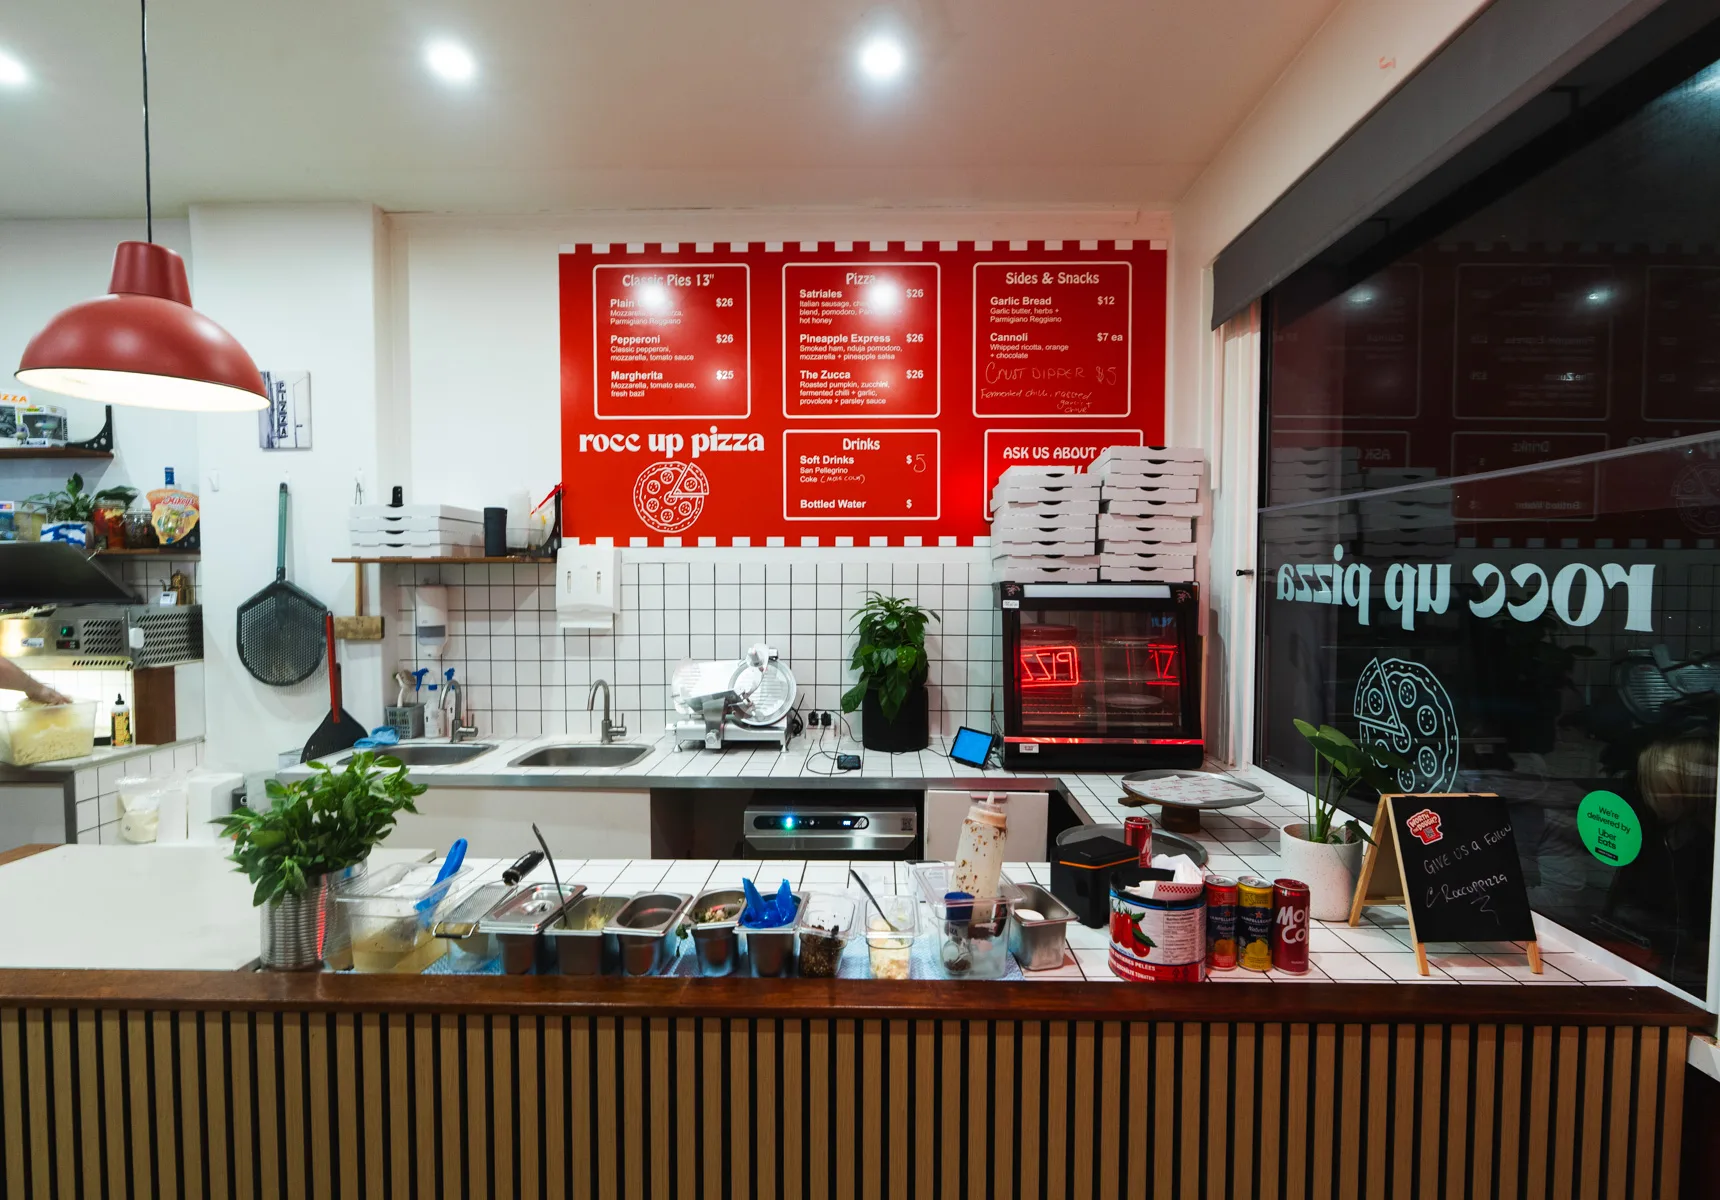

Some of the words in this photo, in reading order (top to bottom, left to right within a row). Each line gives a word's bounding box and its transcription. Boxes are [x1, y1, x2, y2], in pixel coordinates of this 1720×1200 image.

[622, 274, 664, 287] Classic
[667, 274, 692, 287] Pies
[846, 272, 876, 285] Pizza
[1006, 272, 1038, 284] Sides
[1042, 272, 1054, 284] &
[1058, 272, 1099, 284] Snacks
[800, 289, 842, 298] Satriales
[906, 289, 924, 298] $26
[610, 299, 635, 308] Plain
[716, 298, 734, 308] $26
[990, 296, 1019, 306] Garlic
[1022, 297, 1051, 305] Bread
[1097, 296, 1115, 305] $12
[610, 335, 660, 345] Pepperoni
[716, 334, 734, 344] $26
[800, 334, 848, 344] Pineapple
[851, 334, 890, 344] Express
[906, 334, 924, 343] $26
[990, 333, 1028, 342] Cannoli
[1097, 332, 1108, 342] $7
[990, 344, 1019, 352] Whipped
[611, 370, 663, 382] Margherita
[716, 370, 734, 380] $25
[800, 370, 818, 379] The
[820, 370, 851, 379] Zucca
[906, 370, 924, 379] $26
[1032, 367, 1086, 380] DIPPER
[279, 382, 288, 435] PIZZA
[579, 432, 641, 452] rocc
[648, 433, 683, 458] up
[691, 426, 765, 458] pizza
[843, 438, 880, 450] Drinks
[1003, 447, 1028, 459] ASK
[1032, 447, 1050, 459] US
[1053, 447, 1097, 459] ABOUT
[800, 455, 820, 464] Soft
[822, 455, 854, 464] Drinks
[815, 467, 848, 475] Pellegrino
[800, 499, 835, 509] Bottled
[838, 500, 867, 509] Water
[906, 499, 912, 509] $
[1598, 805, 1620, 819] We're
[1410, 814, 1430, 827] WORTH
[1417, 816, 1438, 831] DOUGH?
[1587, 811, 1620, 829] delivered
[1621, 823, 1631, 835] by
[1598, 828, 1617, 840] Uber
[1598, 836, 1616, 849] Eats
[1424, 854, 1451, 874] GIVE
[1453, 845, 1470, 860] US
